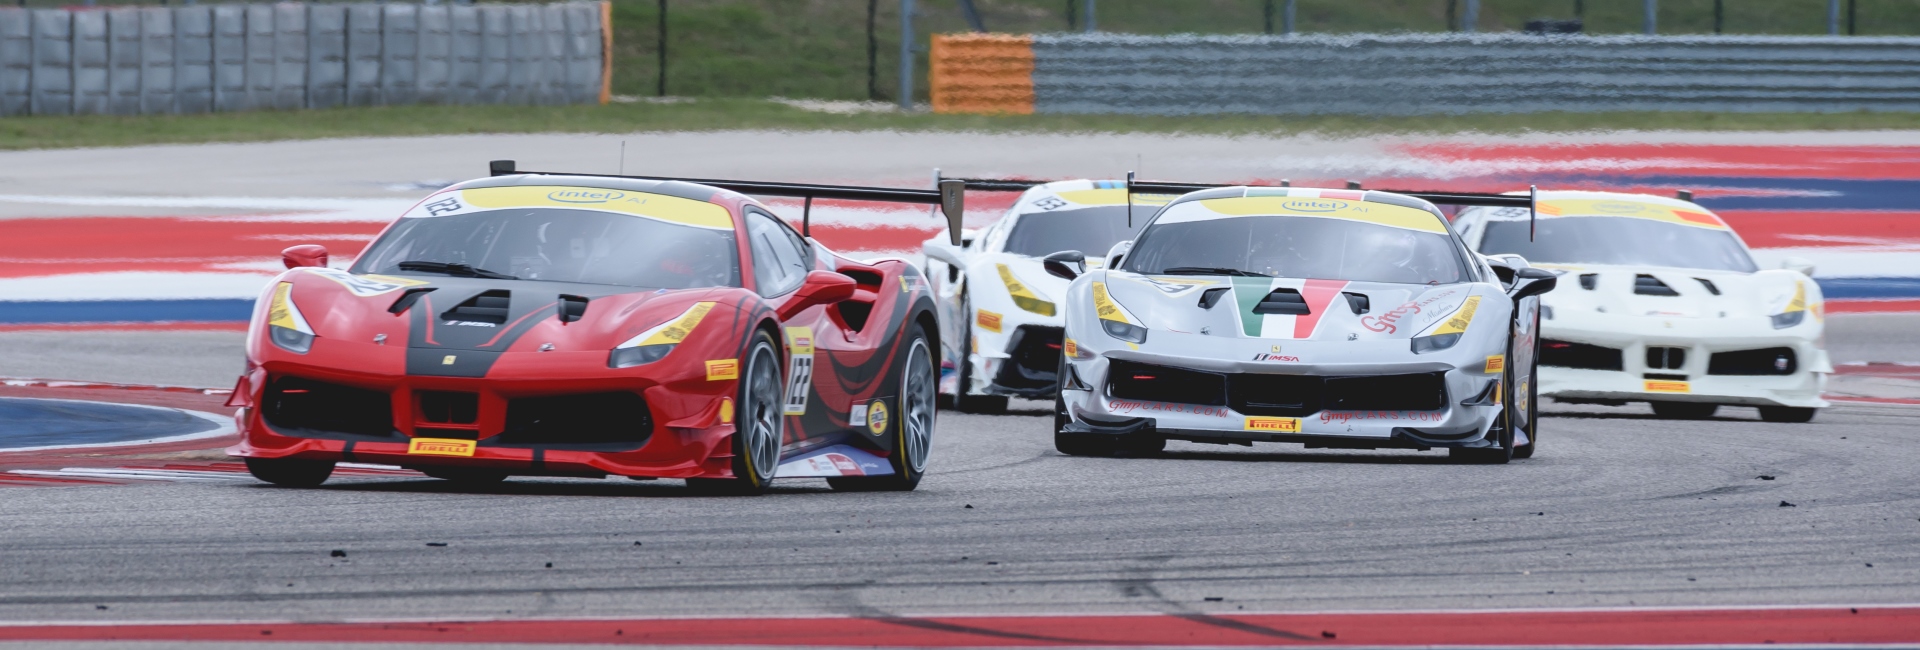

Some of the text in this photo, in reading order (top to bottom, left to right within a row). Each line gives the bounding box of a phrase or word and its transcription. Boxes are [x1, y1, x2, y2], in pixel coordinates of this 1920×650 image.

[557, 188, 648, 205] intel AI
[424, 196, 463, 217] 122
[1290, 200, 1337, 209] intel
[709, 363, 735, 377] PIRELLI
[785, 357, 811, 405] 122
[1249, 419, 1297, 430] PIRELLI
[414, 441, 470, 453] PIRELLI
